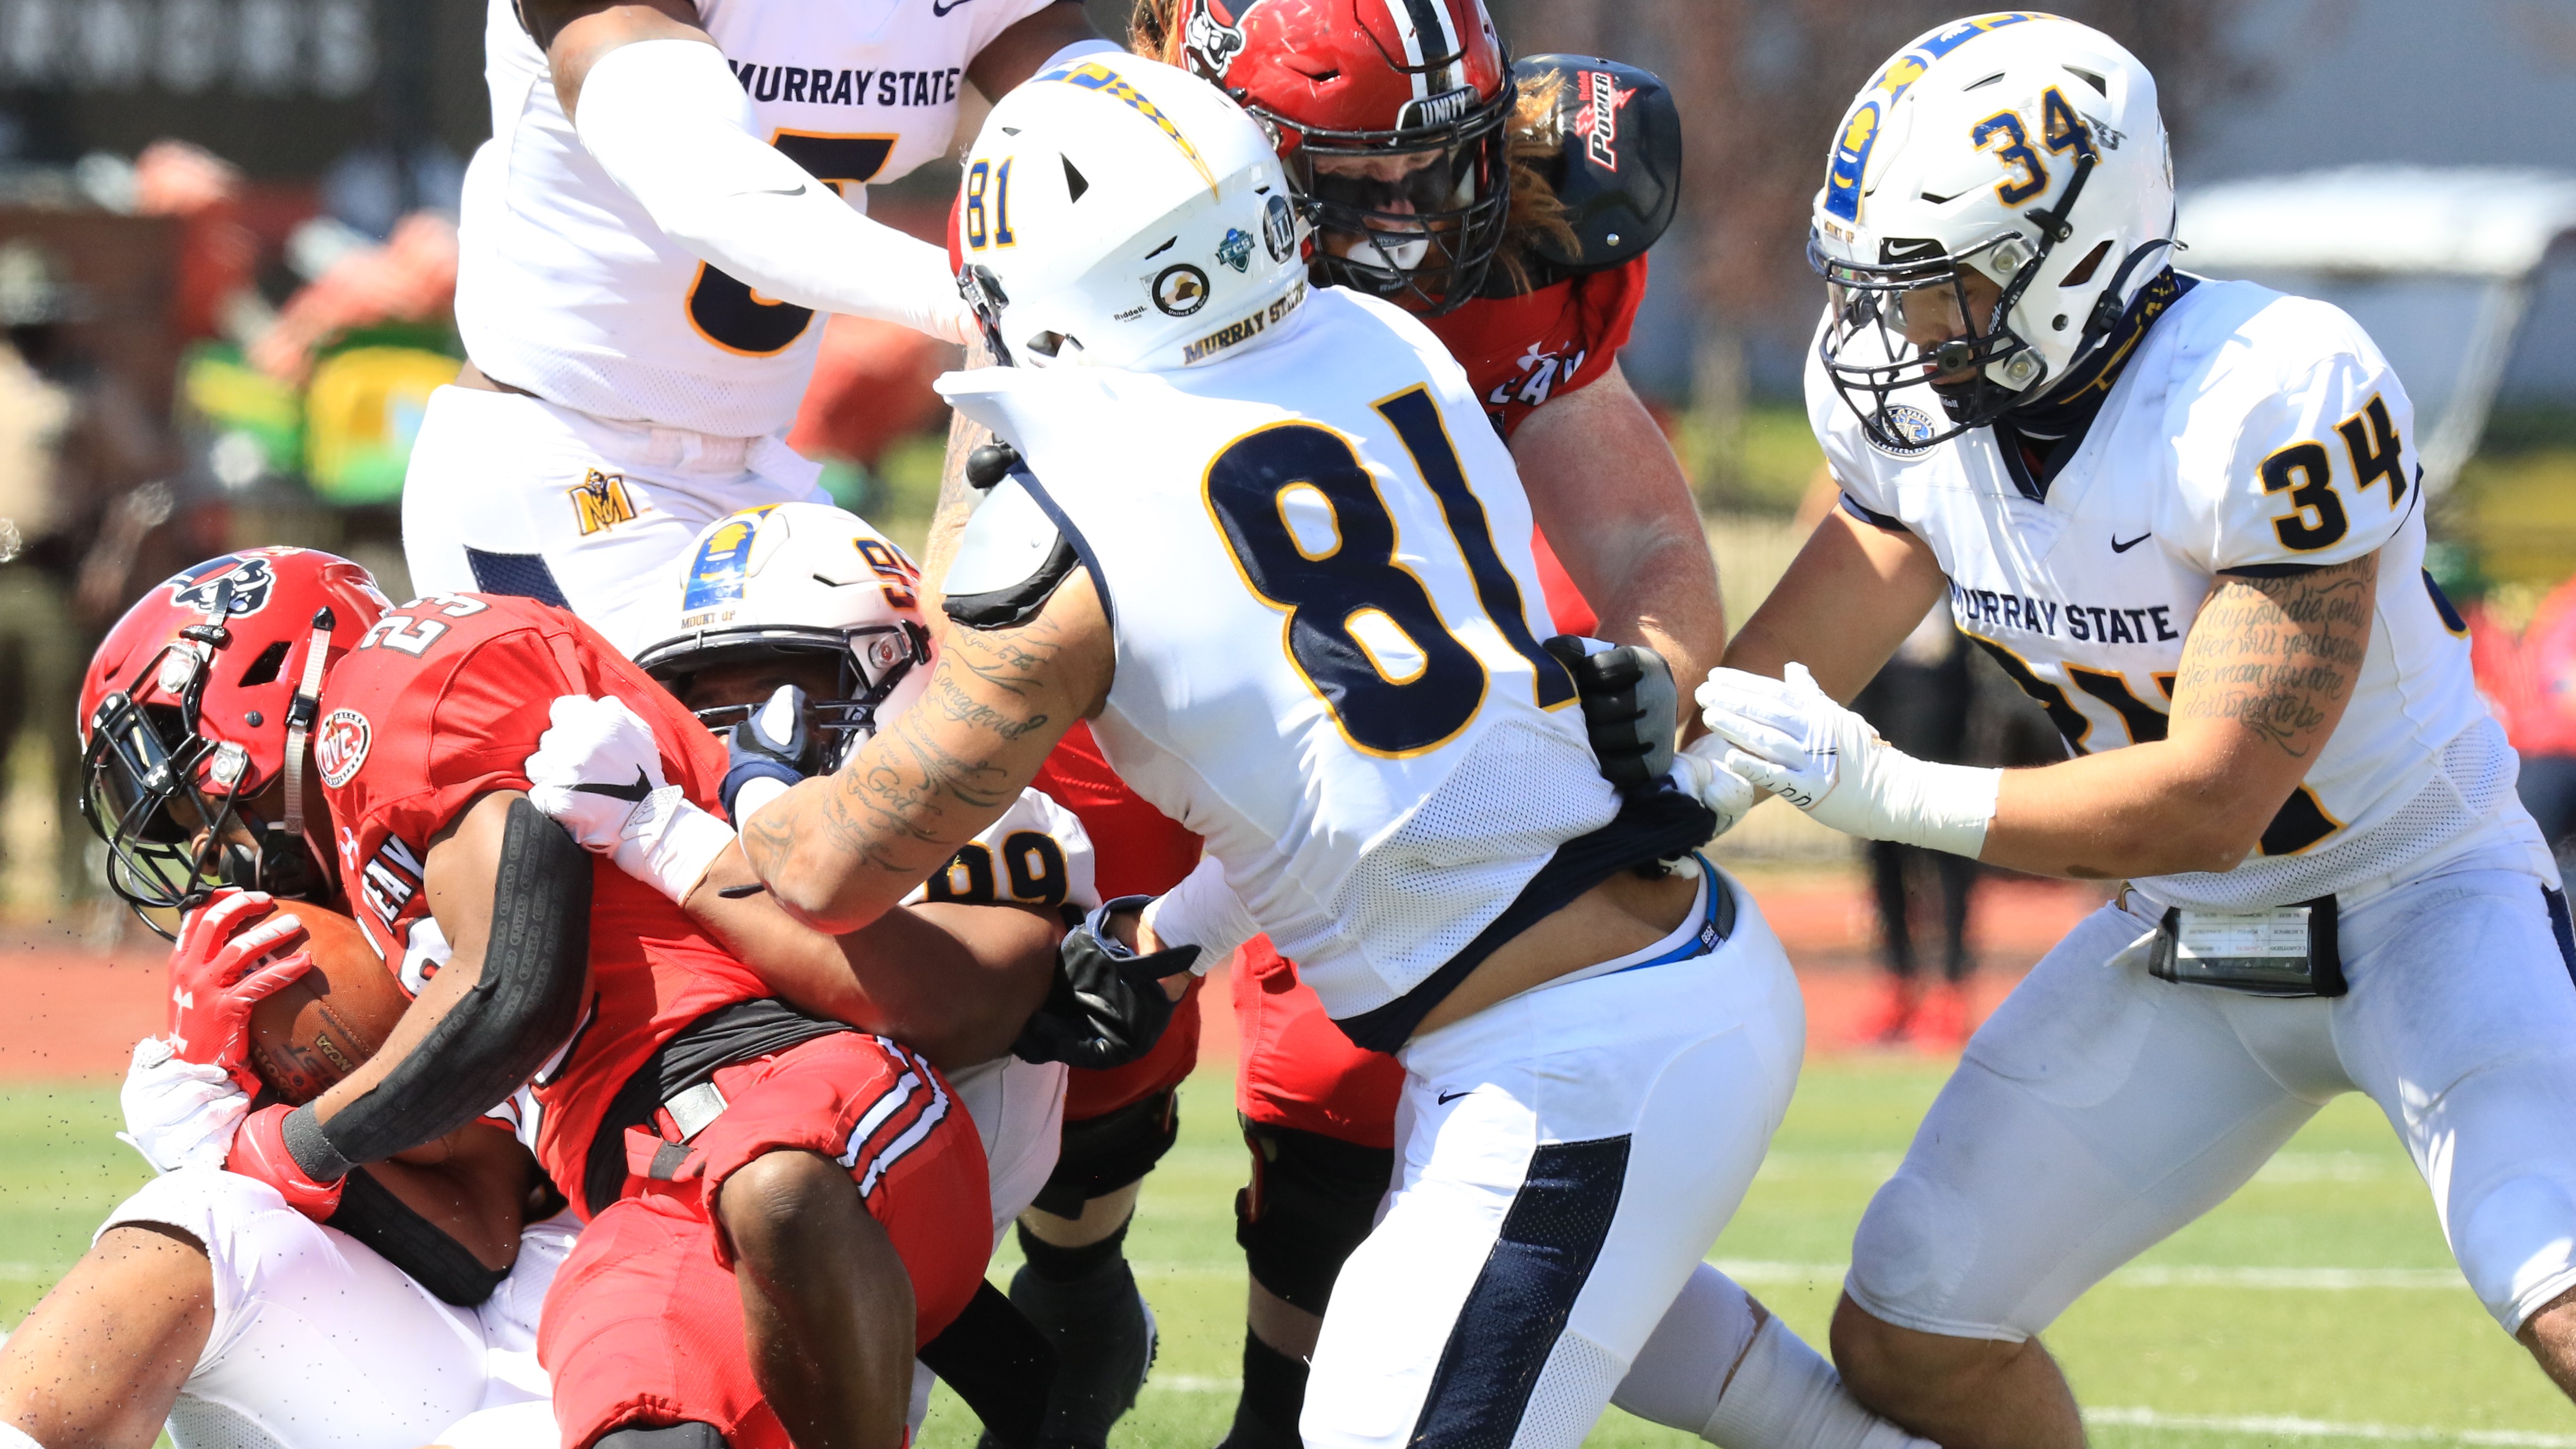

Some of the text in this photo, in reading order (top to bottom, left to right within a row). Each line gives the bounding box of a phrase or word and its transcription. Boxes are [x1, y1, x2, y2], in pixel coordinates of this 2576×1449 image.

[728, 59, 960, 107] MURRAY STATE
[1420, 91, 1465, 127] UNITY
[1589, 73, 1616, 171] POWER
[1970, 84, 2103, 209] 34
[966, 155, 1017, 253] 81
[1113, 305, 1145, 321] Riddell
[1183, 310, 1265, 365] MURRAY
[2257, 391, 2409, 554] 34
[1200, 381, 1581, 760] 81
[357, 592, 492, 659] 23
[681, 610, 736, 630] MOUNT UP
[1948, 576, 2180, 643] MURRAY STATE
[868, 766, 930, 813] God
[315, 1033, 353, 1072] NCAA
